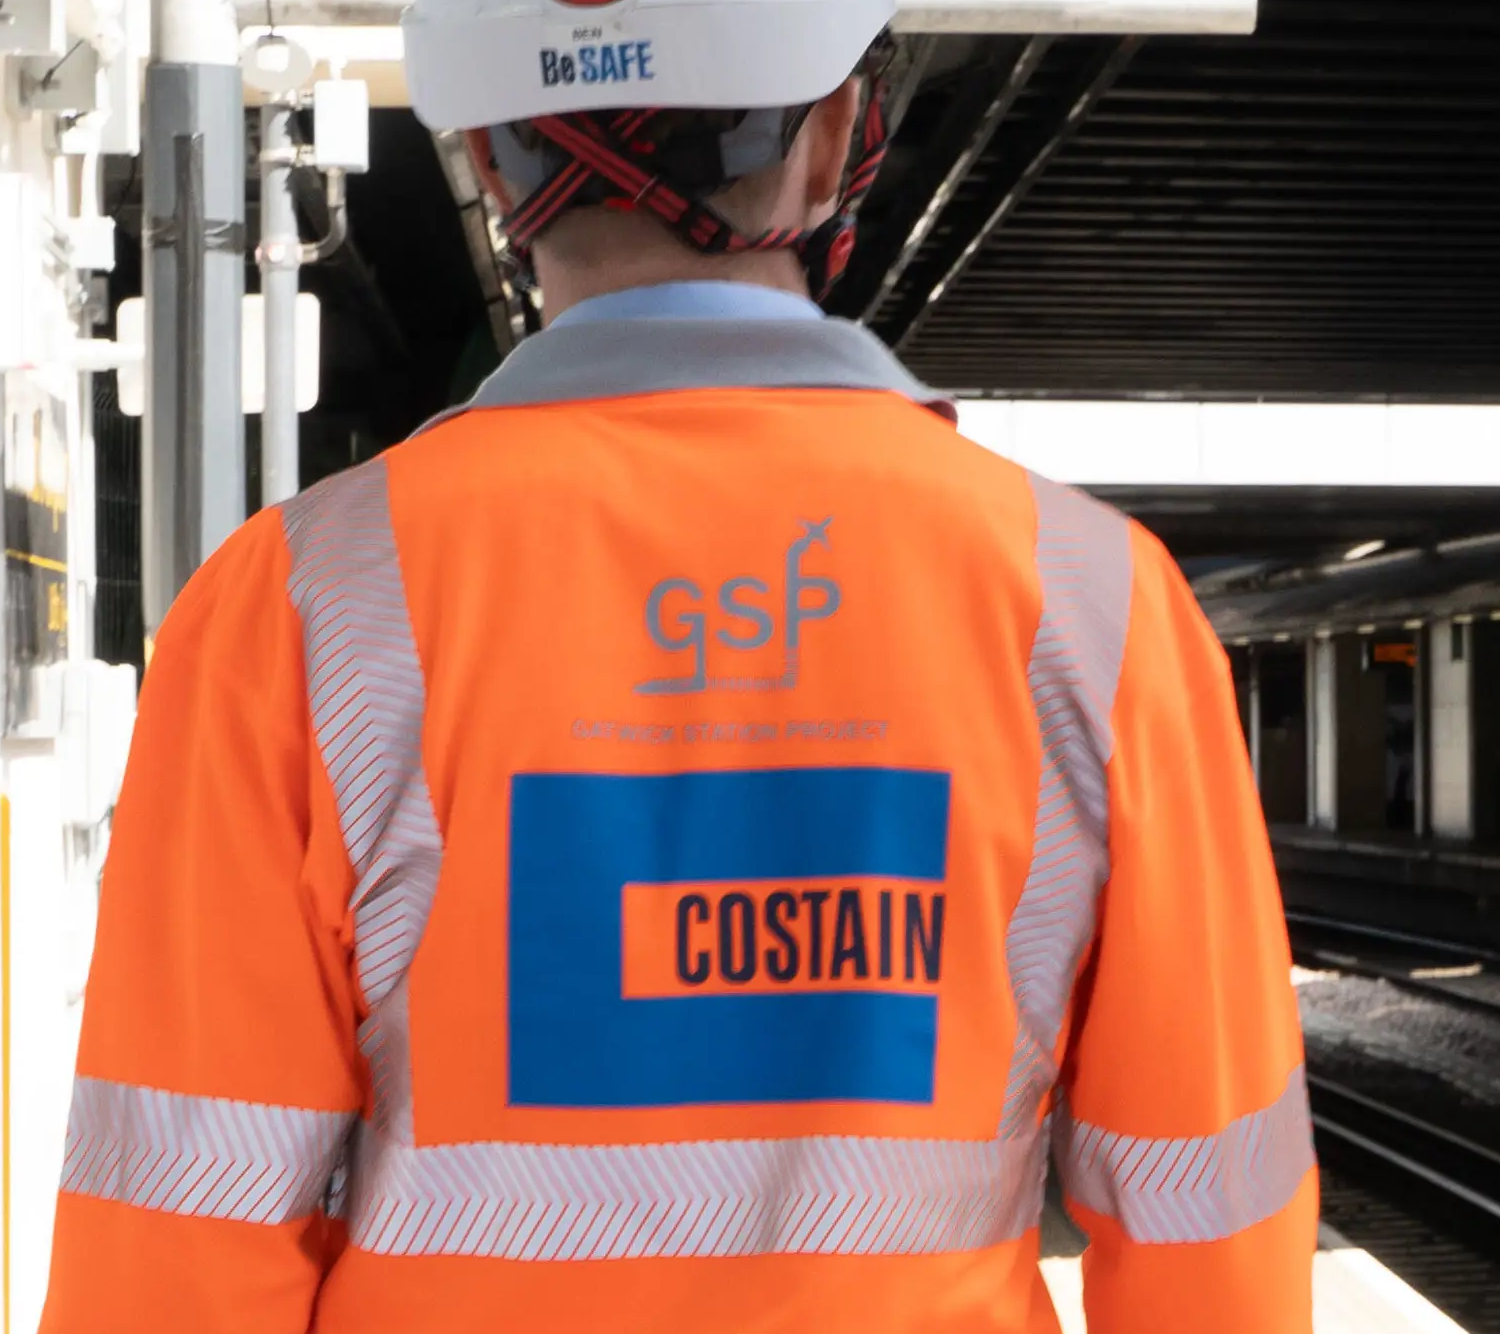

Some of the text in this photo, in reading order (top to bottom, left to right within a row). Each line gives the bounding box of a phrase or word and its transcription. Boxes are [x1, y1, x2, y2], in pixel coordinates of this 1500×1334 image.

[640, 533, 842, 692] GSP
[683, 722, 779, 743] STATION
[784, 720, 889, 741] PROJECT
[675, 888, 947, 985] COSTAIN
